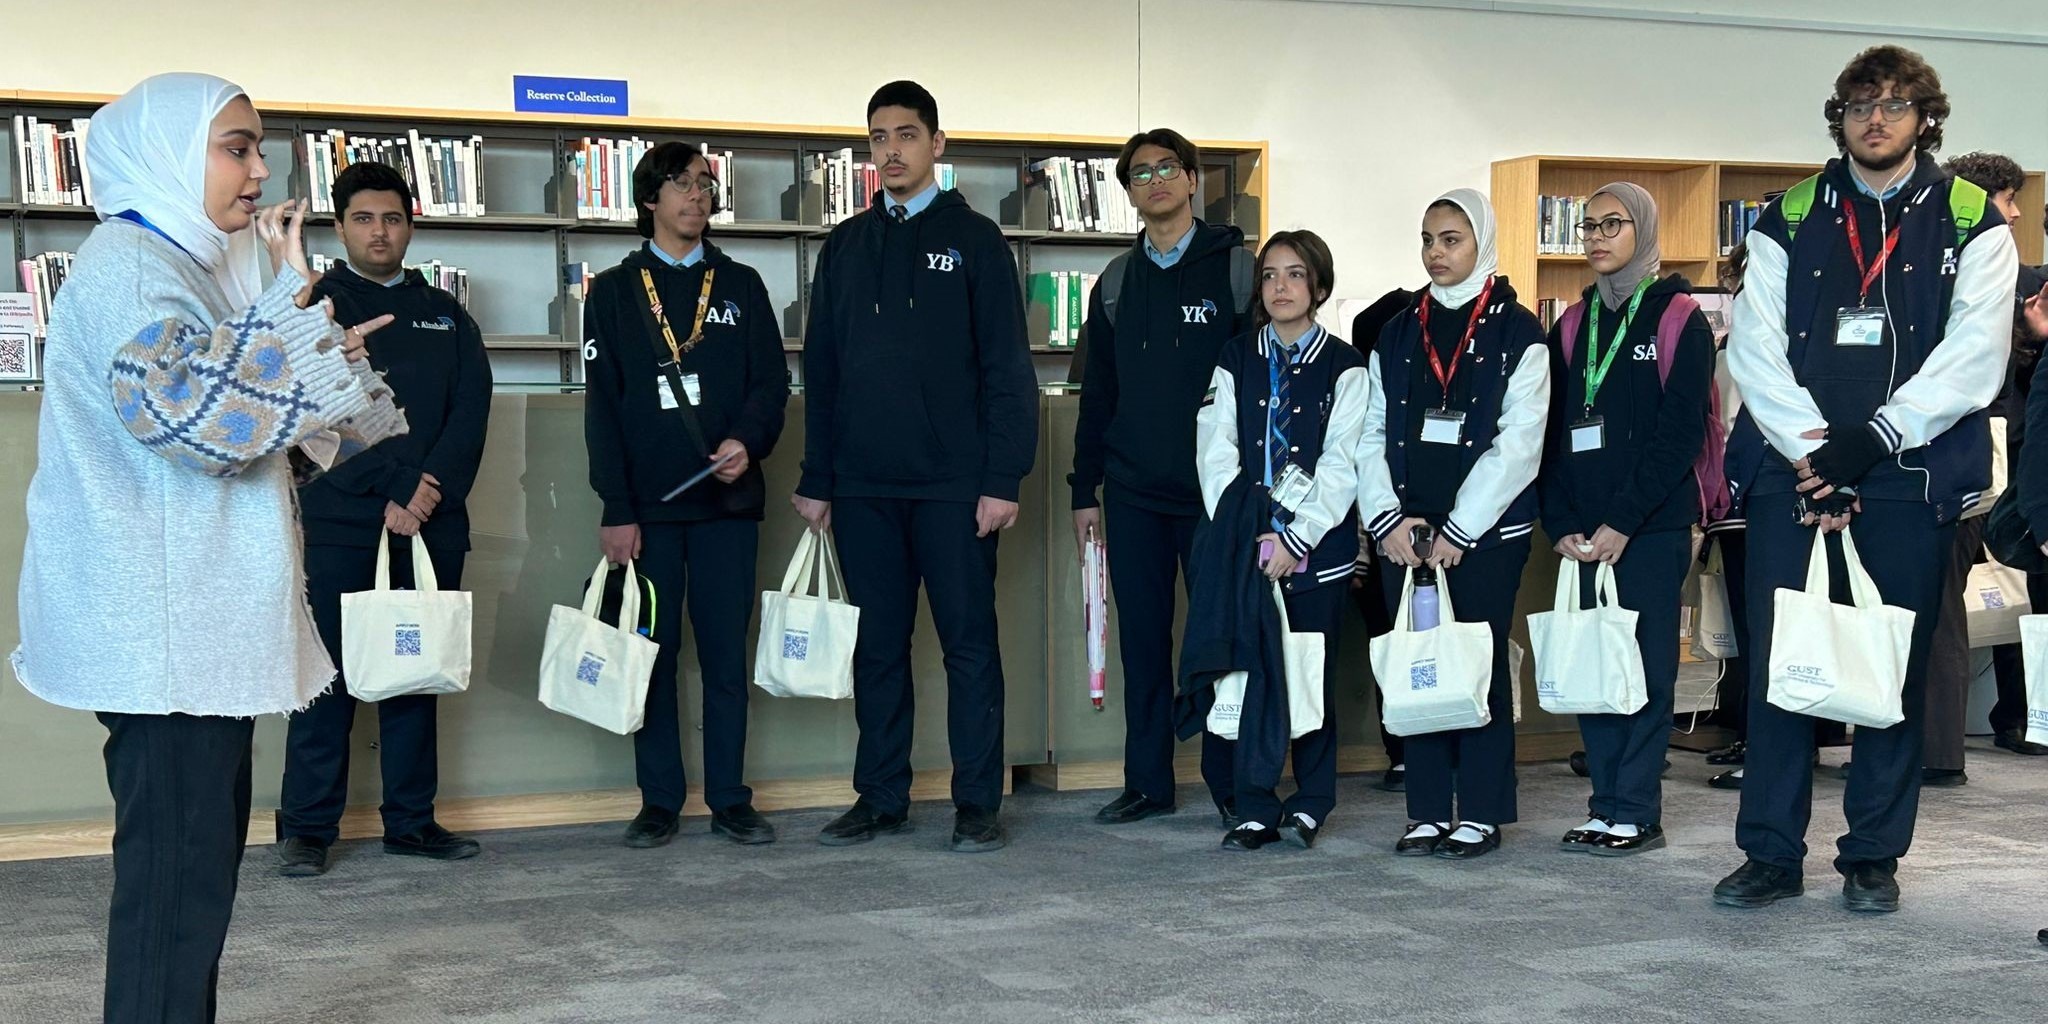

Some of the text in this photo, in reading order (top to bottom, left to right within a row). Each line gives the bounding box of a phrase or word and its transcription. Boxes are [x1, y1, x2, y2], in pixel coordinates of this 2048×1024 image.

[526, 89, 617, 104] Reserve Collection
[926, 253, 954, 272] YB
[705, 307, 737, 326] AA
[1181, 305, 1208, 324] YK
[583, 338, 598, 361] 6
[1632, 343, 1658, 361] SA
[1787, 664, 1823, 676] GUST
[1214, 703, 1242, 713] GUST
